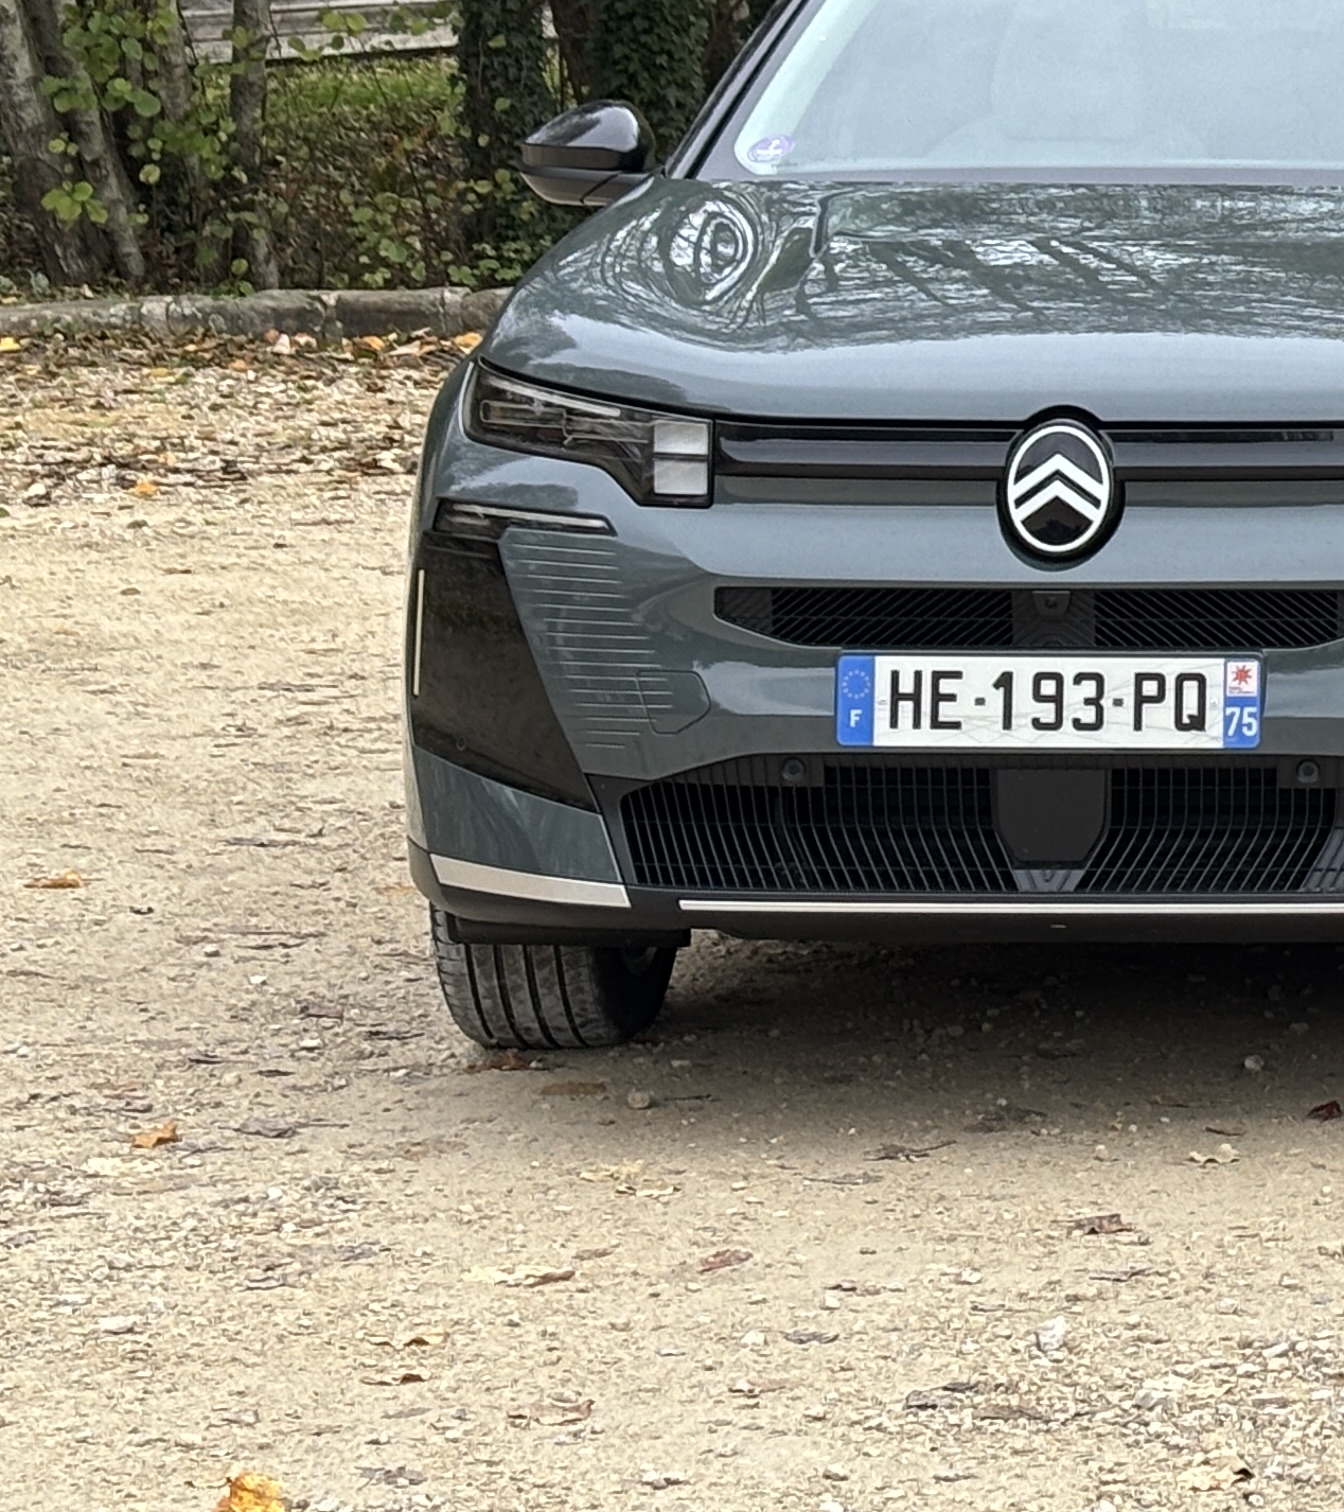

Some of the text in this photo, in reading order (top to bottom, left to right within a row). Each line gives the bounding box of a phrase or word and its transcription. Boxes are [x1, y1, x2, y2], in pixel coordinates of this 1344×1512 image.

[889, 669, 1207, 732] HE-193-PQ
[850, 709, 862, 728] F
[1225, 706, 1258, 737] 75
